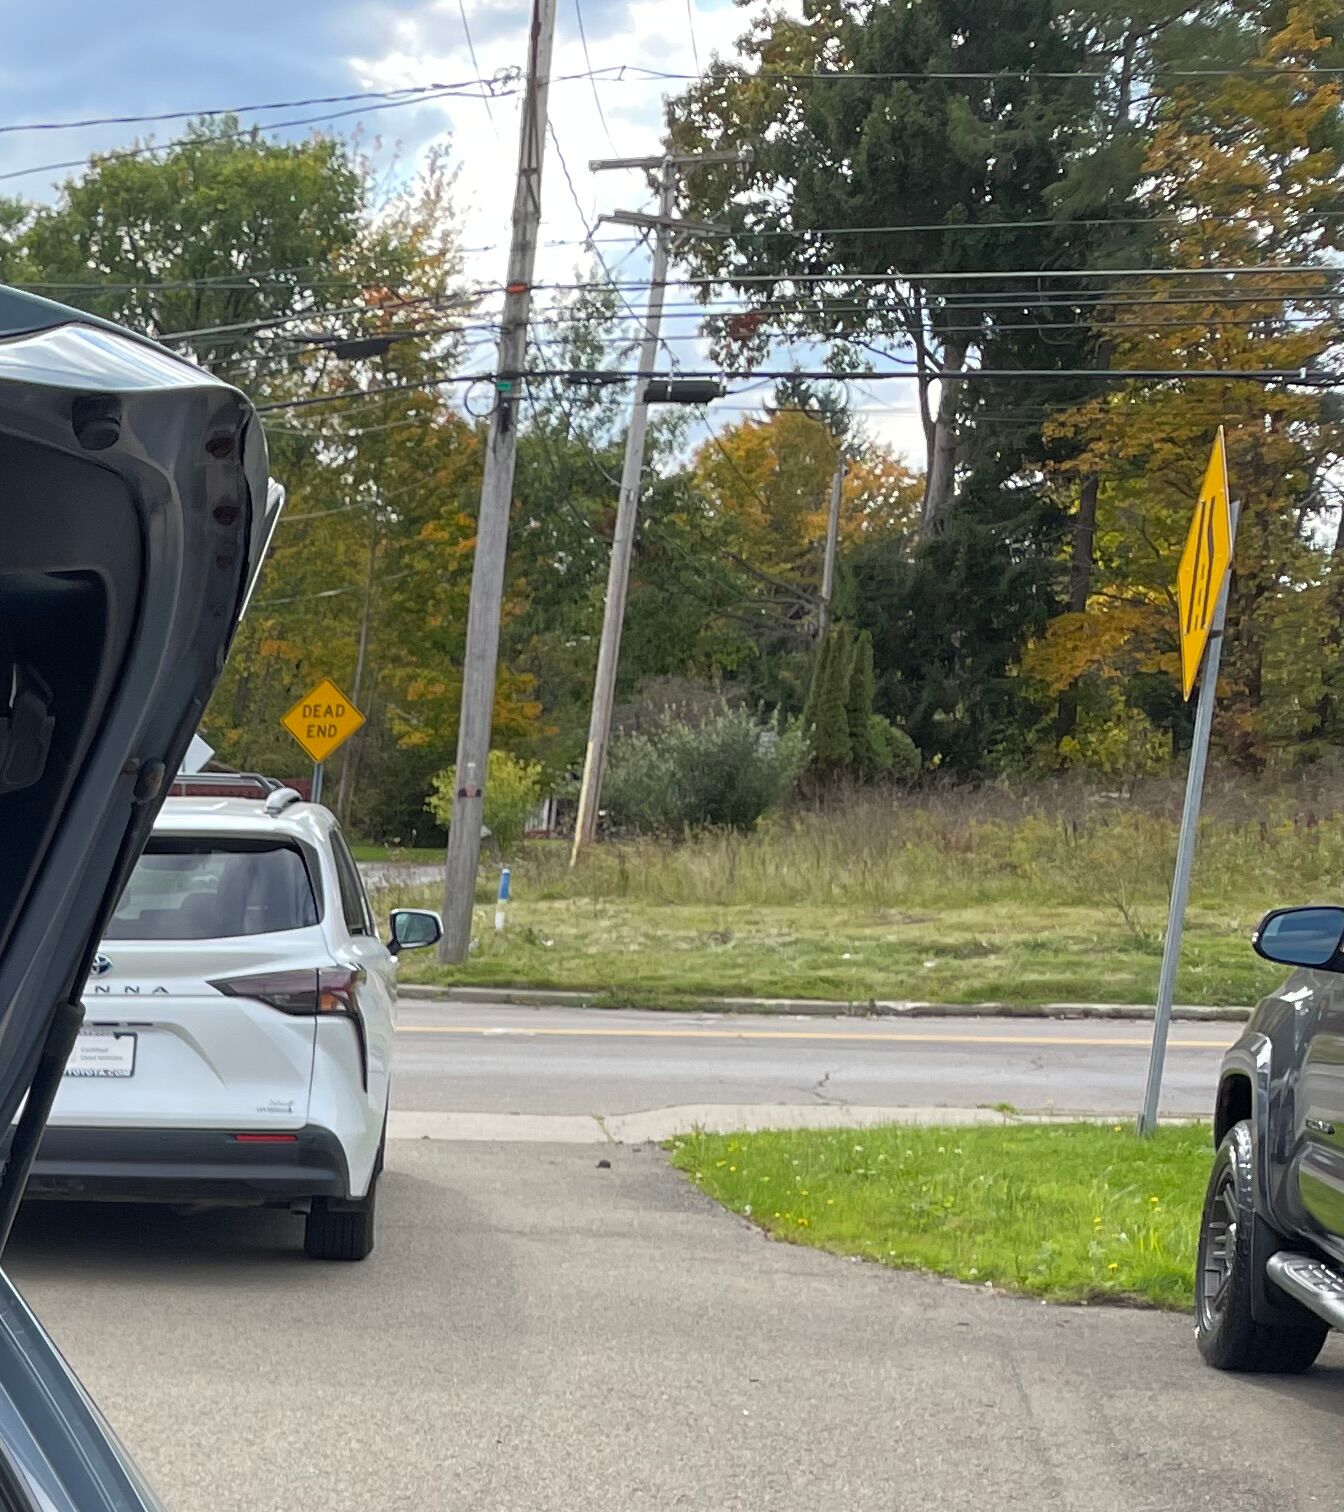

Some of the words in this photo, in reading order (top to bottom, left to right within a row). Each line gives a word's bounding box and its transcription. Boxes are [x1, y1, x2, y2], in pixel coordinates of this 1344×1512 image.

[302, 704, 346, 719] DEAD
[306, 724, 338, 739] END
[95, 985, 169, 994] NNA
